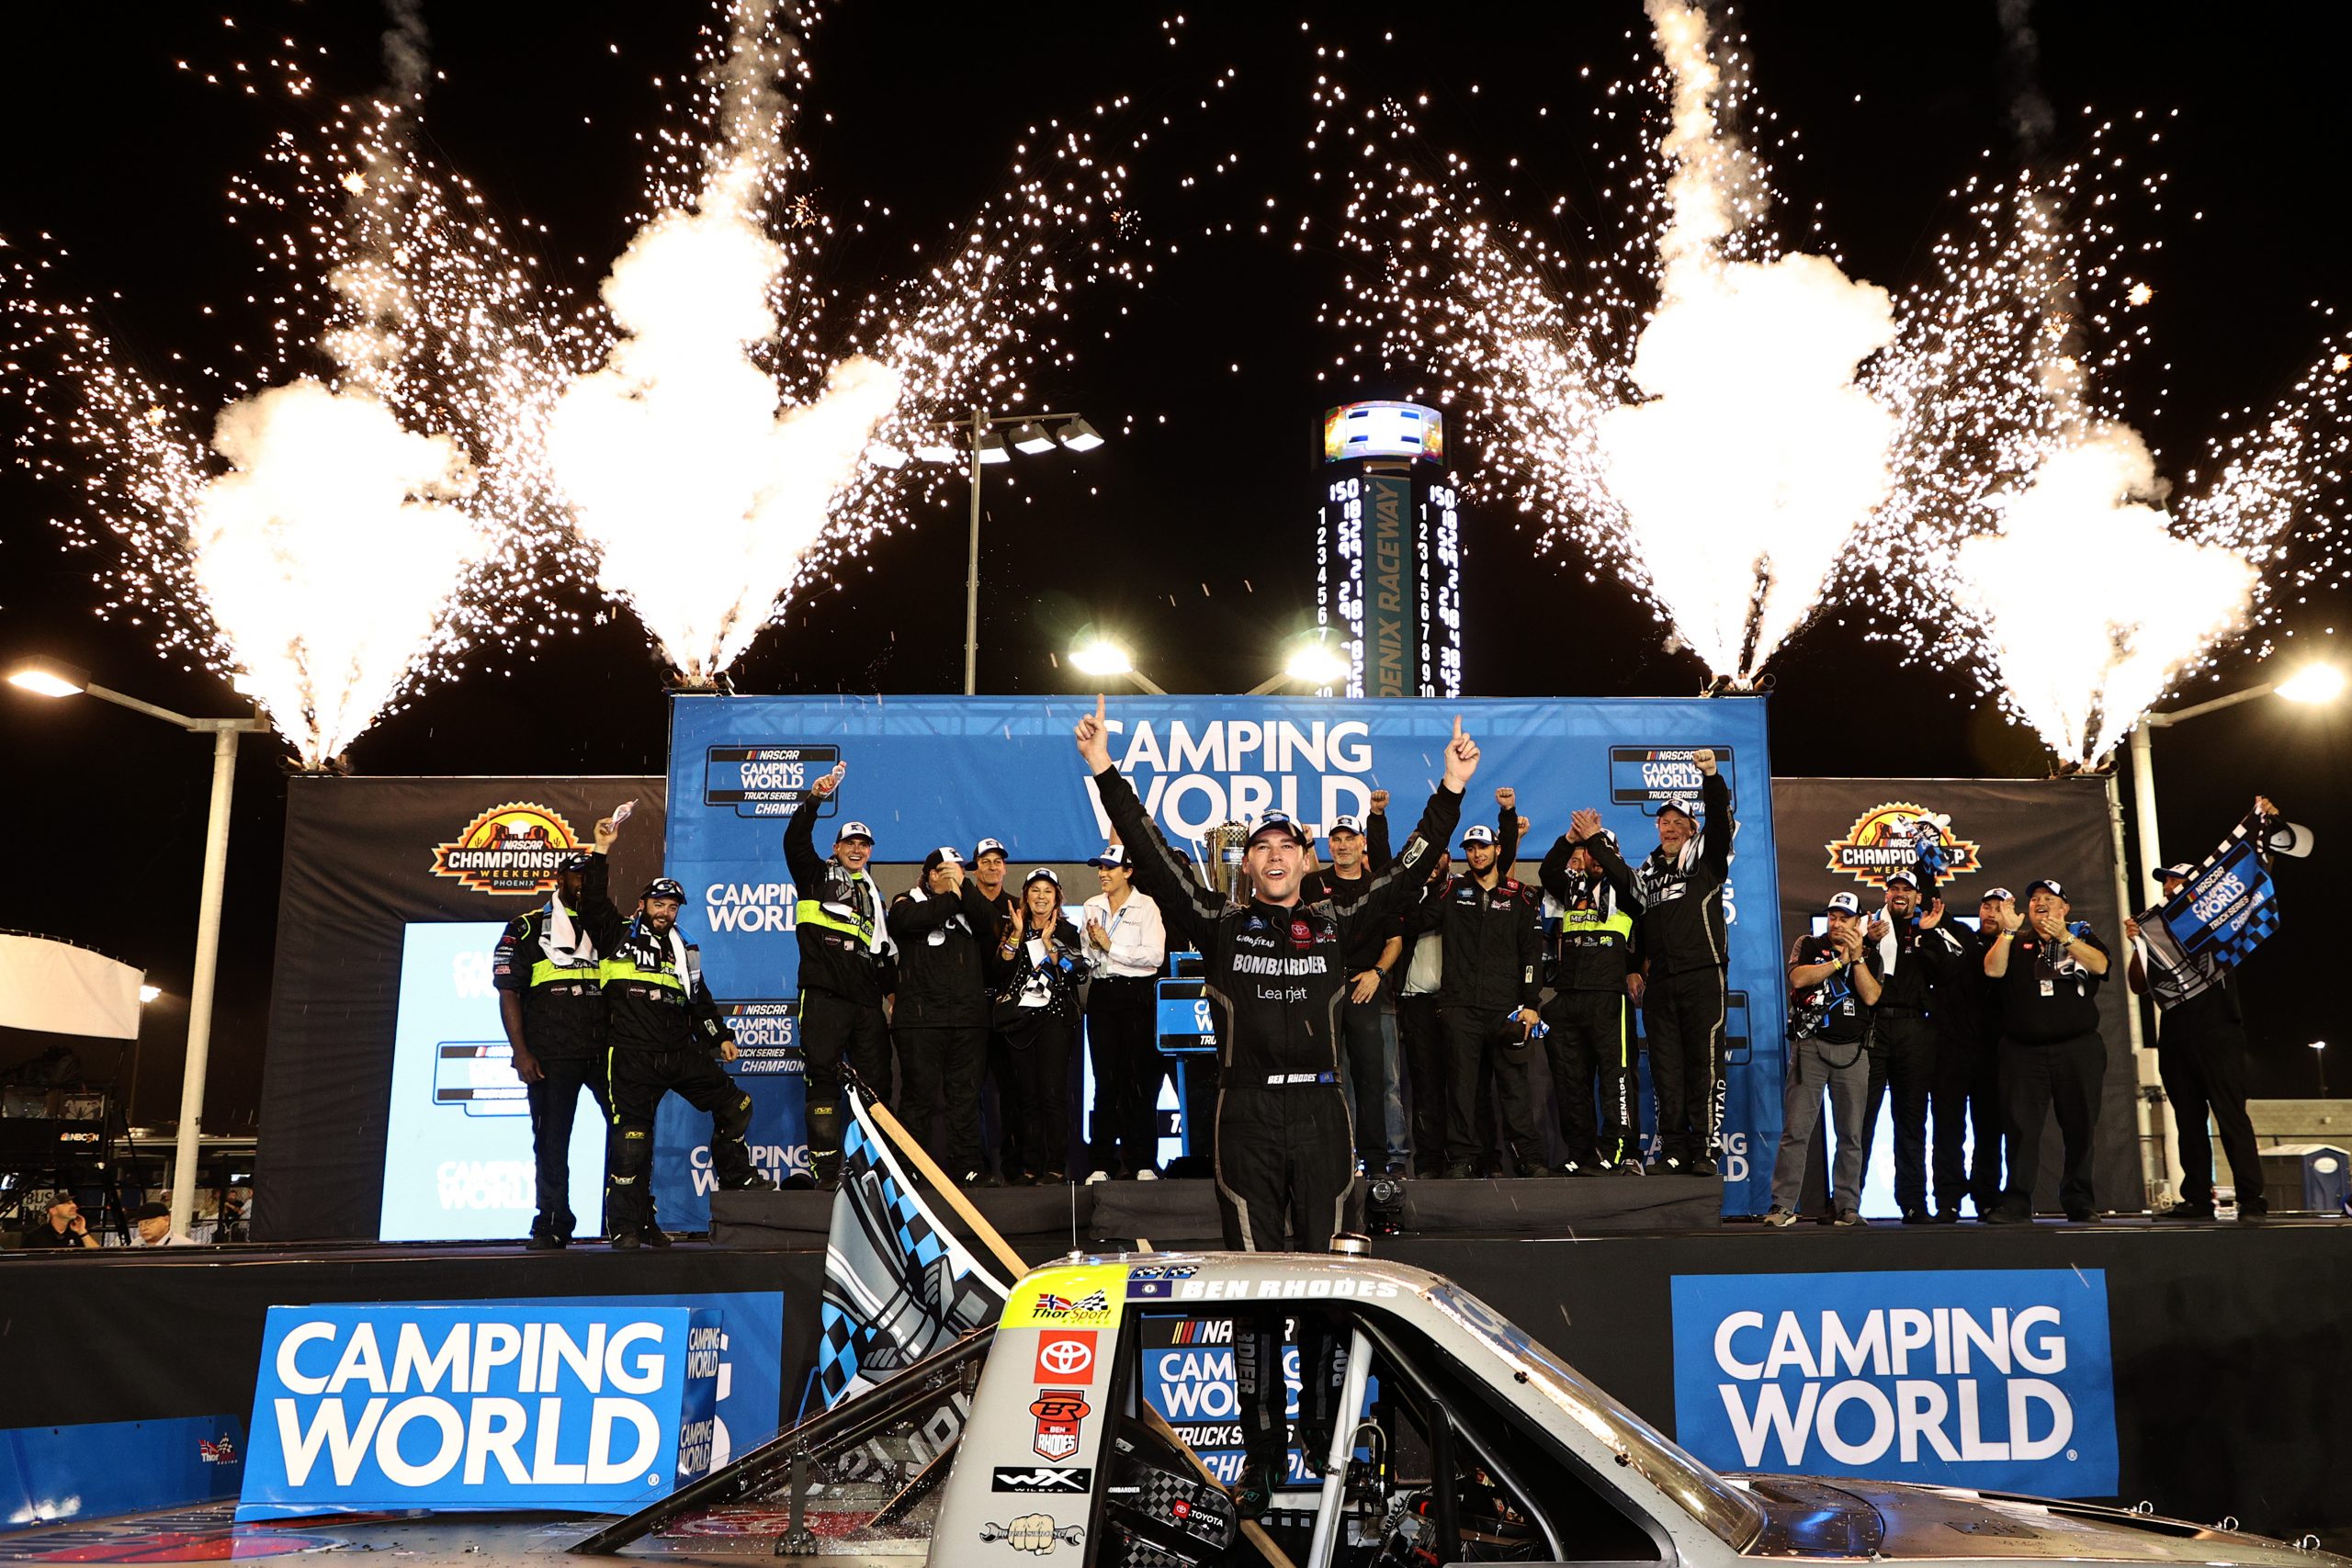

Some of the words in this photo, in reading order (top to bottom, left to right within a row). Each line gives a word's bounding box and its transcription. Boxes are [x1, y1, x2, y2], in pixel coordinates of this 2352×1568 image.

[1329, 478, 1360, 502] 150
[1430, 485, 1455, 509] 150
[1317, 507, 1327, 525] 1
[1343, 499, 1363, 520] 18
[1419, 502, 1428, 521] 1
[1442, 510, 1458, 530] 18
[1317, 527, 1328, 545] 2
[1338, 519, 1363, 542] 52
[1419, 524, 1429, 540] 2
[1437, 526, 1458, 549] 52
[1317, 547, 1328, 565] 3
[1338, 539, 1363, 559] 99
[1375, 481, 1402, 613] RACEWAY
[1419, 544, 1429, 560] 3
[1437, 547, 1459, 569] 99
[1317, 567, 1328, 584] 4
[1350, 559, 1363, 580] 2
[1419, 562, 1430, 581] 4
[1447, 569, 1459, 590] 2
[1317, 587, 1328, 604] 5
[1338, 580, 1363, 602] 21
[1419, 582, 1430, 601] 5
[1438, 586, 1460, 608] 21
[1317, 607, 1328, 626] 6
[1338, 599, 1363, 620] 98
[1420, 603, 1430, 620] 6
[1438, 606, 1461, 629] 98
[1317, 626, 1329, 642] 7
[1350, 621, 1363, 637] 4
[1420, 623, 1430, 641] 7
[1449, 630, 1461, 649] 4
[1420, 642, 1430, 661] 8
[1440, 646, 1461, 670] 38
[1421, 663, 1431, 682] 9
[1440, 667, 1462, 690] 42
[759, 750, 800, 761] NASCAR
[740, 762, 805, 775] CAMPING
[1642, 762, 1703, 774] CAMPING
[740, 774, 805, 789] WORLD
[1643, 774, 1703, 788] WORLD
[743, 792, 769, 800] TRUCK
[769, 792, 797, 800] SERIES
[1648, 790, 1673, 799] TRUCK
[1672, 790, 1699, 799] SERIES
[754, 803, 803, 815] CHAMP
[503, 840, 544, 851] NASCAR
[1890, 838, 1916, 848] NASC
[447, 852, 577, 869] CHAMPIONSH
[480, 869, 551, 878] WEEKEND
[2195, 865, 2224, 896] NASCAR
[706, 883, 798, 906] CAMPIN
[2192, 872, 2239, 914] CAMPING
[2196, 881, 2246, 922] WORLD
[706, 905, 797, 932] WORL
[2208, 910, 2231, 931] TRUCK
[2228, 895, 2249, 917] SERIES
[1236, 933, 1276, 948] GOODYEAR
[1232, 953, 1328, 976] BOMBARDIER
[1257, 984, 1308, 1004] Learjet
[745, 1004, 788, 1016] NASCAR
[726, 1018, 792, 1031] CAMPING
[734, 1030, 792, 1045] WORLD
[737, 1048, 758, 1057] UCK
[756, 1048, 786, 1057] SERIES
[741, 1060, 806, 1072] CHAMPION
[1267, 1073, 1284, 1085] BEN
[1287, 1073, 1317, 1084] RHODES
[690, 1145, 811, 1169] CPING
[1180, 1280, 1250, 1299] BEN
[1257, 1277, 1399, 1298] RHODES
[689, 1327, 720, 1351] CAMPING
[1713, 1305, 2067, 1380] CAMPING
[276, 1321, 665, 1395] CAMPING
[687, 1350, 718, 1380] WORLD
[1159, 1349, 1301, 1382] CAMG
[680, 1419, 713, 1449] CAMPING
[1049, 1426, 1066, 1434] BEN
[1717, 1378, 2075, 1468] WORLD
[274, 1395, 662, 1487] WORLD
[1037, 1434, 1076, 1457] RHODES
[678, 1443, 711, 1477] WORLD
[1191, 1509, 1224, 1528] TOYOTA
